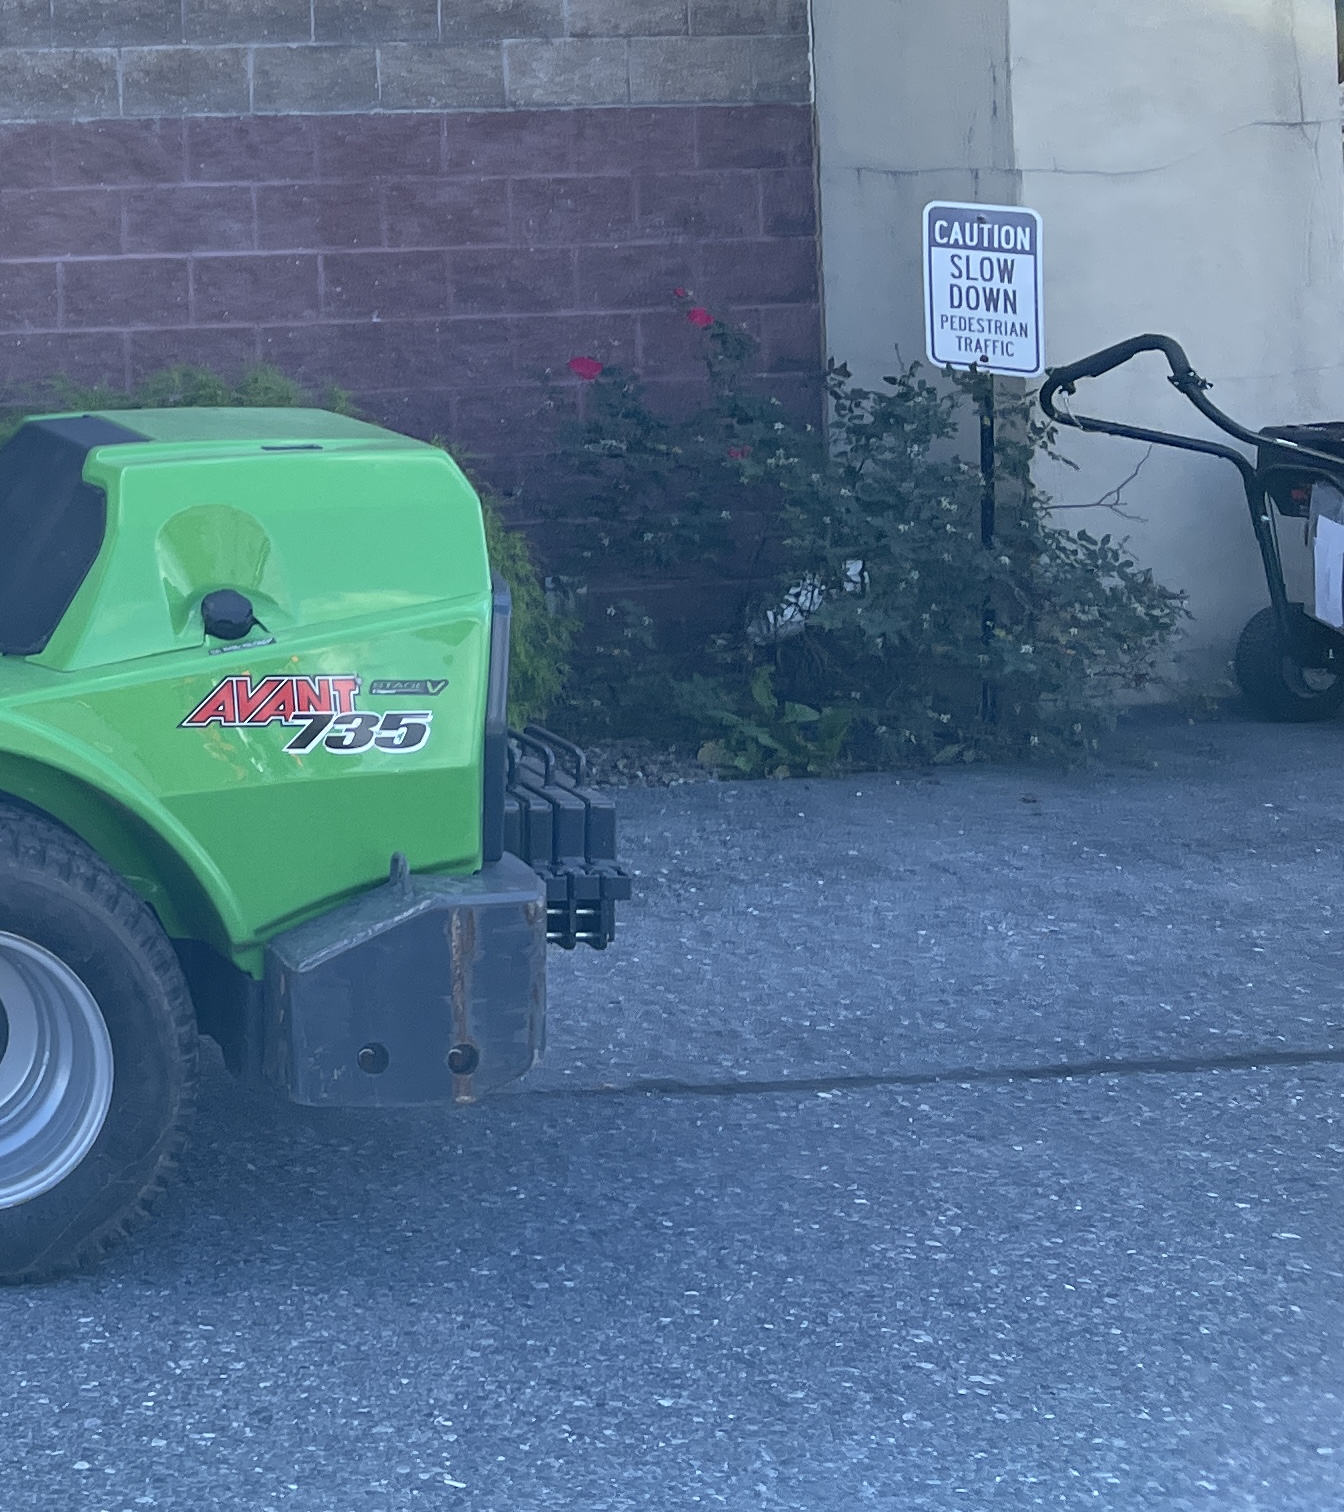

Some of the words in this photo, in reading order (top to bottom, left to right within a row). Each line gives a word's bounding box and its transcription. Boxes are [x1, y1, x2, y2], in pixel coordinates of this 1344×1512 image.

[934, 219, 1031, 251] CAUTION
[950, 254, 1016, 284] SLOW
[949, 283, 1017, 315] DOWN
[940, 313, 1029, 339] PEDESTRIAN
[955, 335, 1015, 357] TRAFFIC
[176, 674, 360, 728] AVANT
[282, 710, 434, 755] 735
